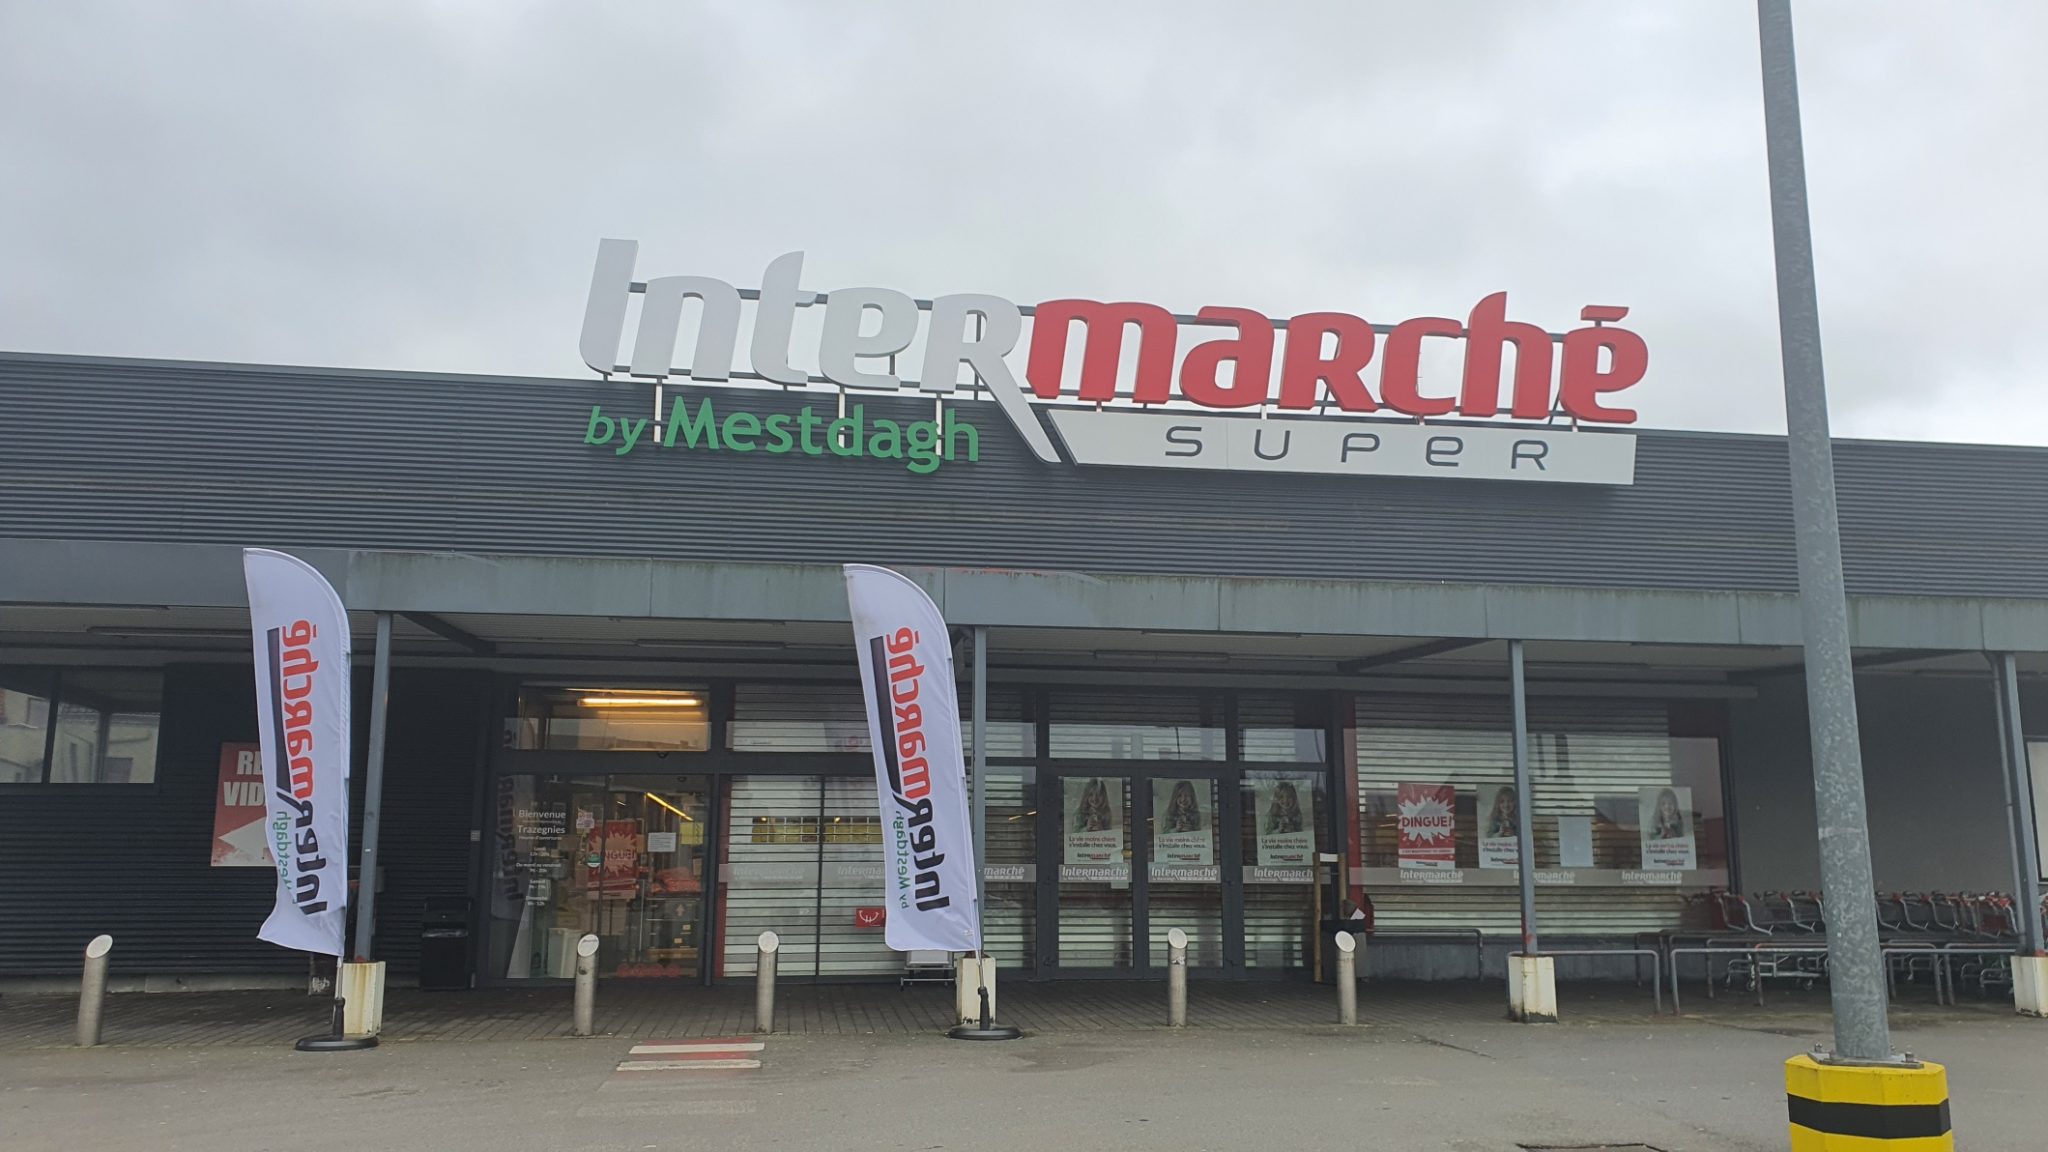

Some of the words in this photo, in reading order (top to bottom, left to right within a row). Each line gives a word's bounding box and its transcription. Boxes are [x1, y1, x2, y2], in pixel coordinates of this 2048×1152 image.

[578, 238, 1648, 462] Intermarché
[584, 406, 648, 455] by
[663, 395, 979, 473] Mestdagh
[223, 782, 267, 806] VID
[518, 809, 566, 819] Bienvenue
[517, 824, 566, 836] Trazegnies
[1151, 867, 1218, 880] Intermarché
[1254, 867, 1313, 881] Intermarch
